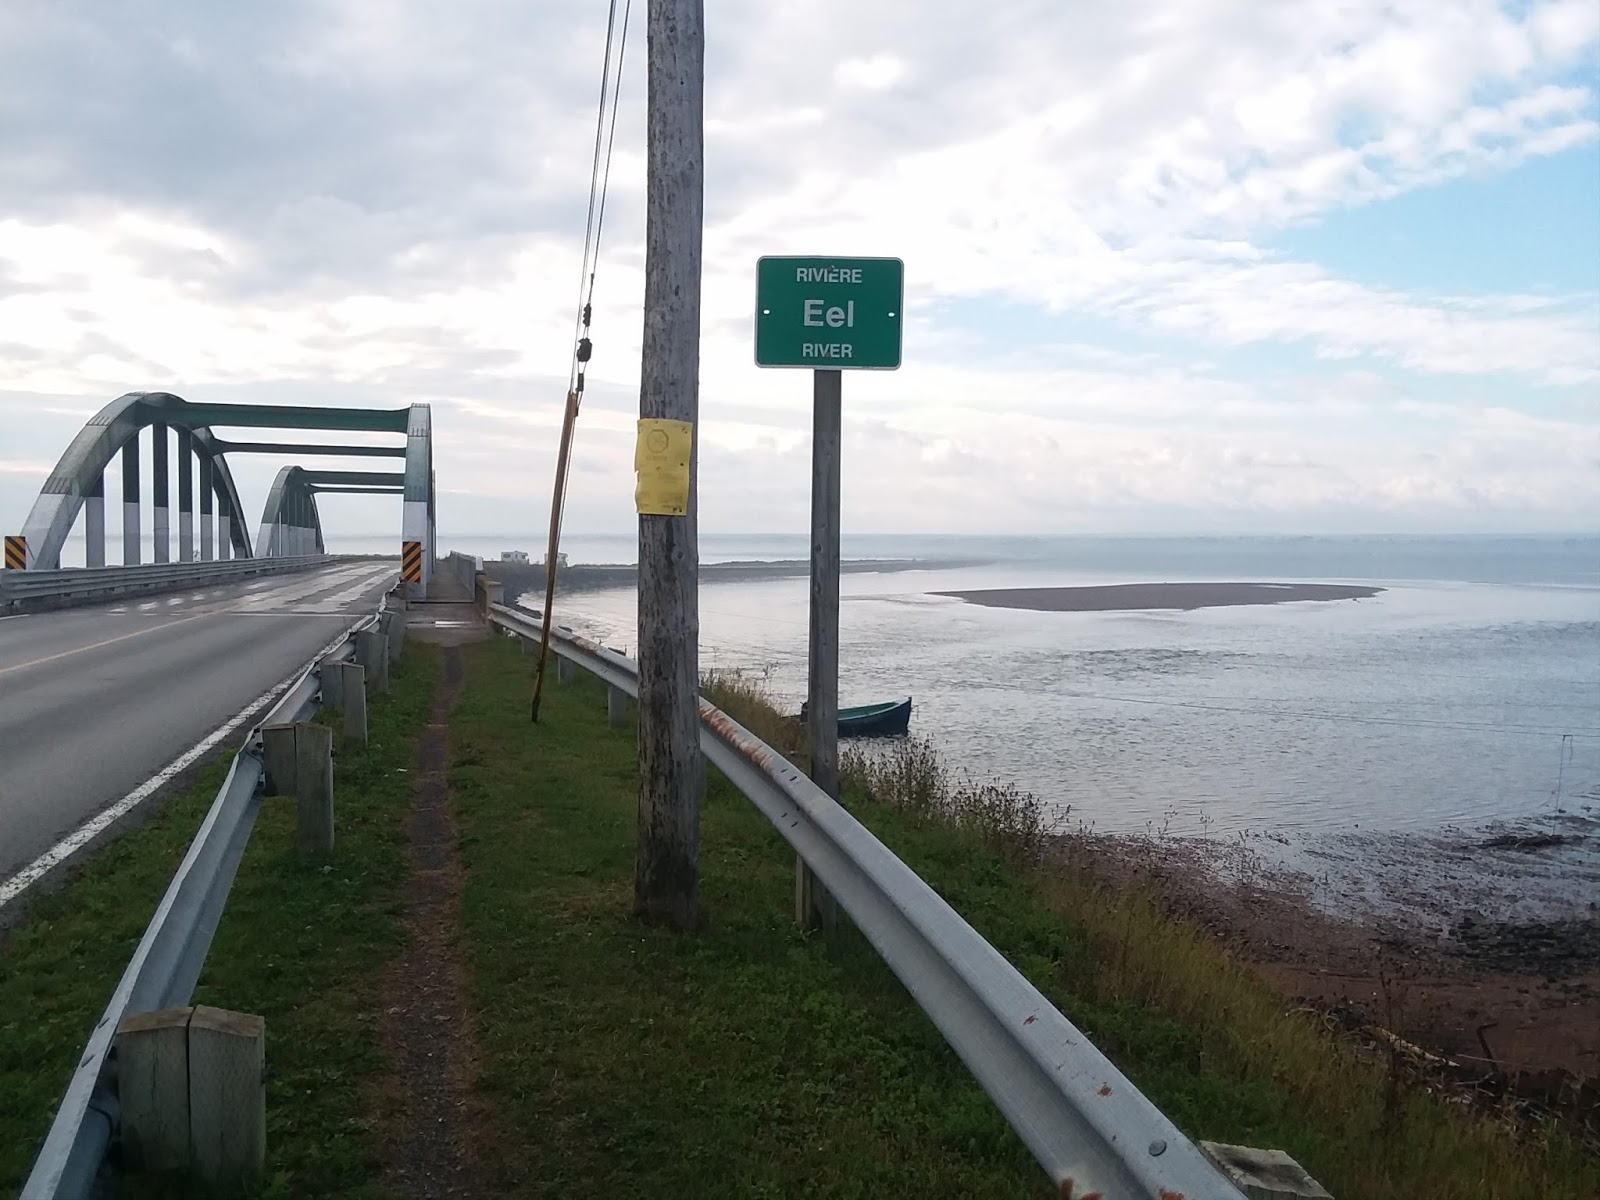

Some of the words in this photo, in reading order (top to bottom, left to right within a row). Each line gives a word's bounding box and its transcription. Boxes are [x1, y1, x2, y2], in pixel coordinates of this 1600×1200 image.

[796, 265, 863, 284] RIVIÈRE
[803, 299, 854, 328] Eel
[802, 343, 853, 358] RIVER
